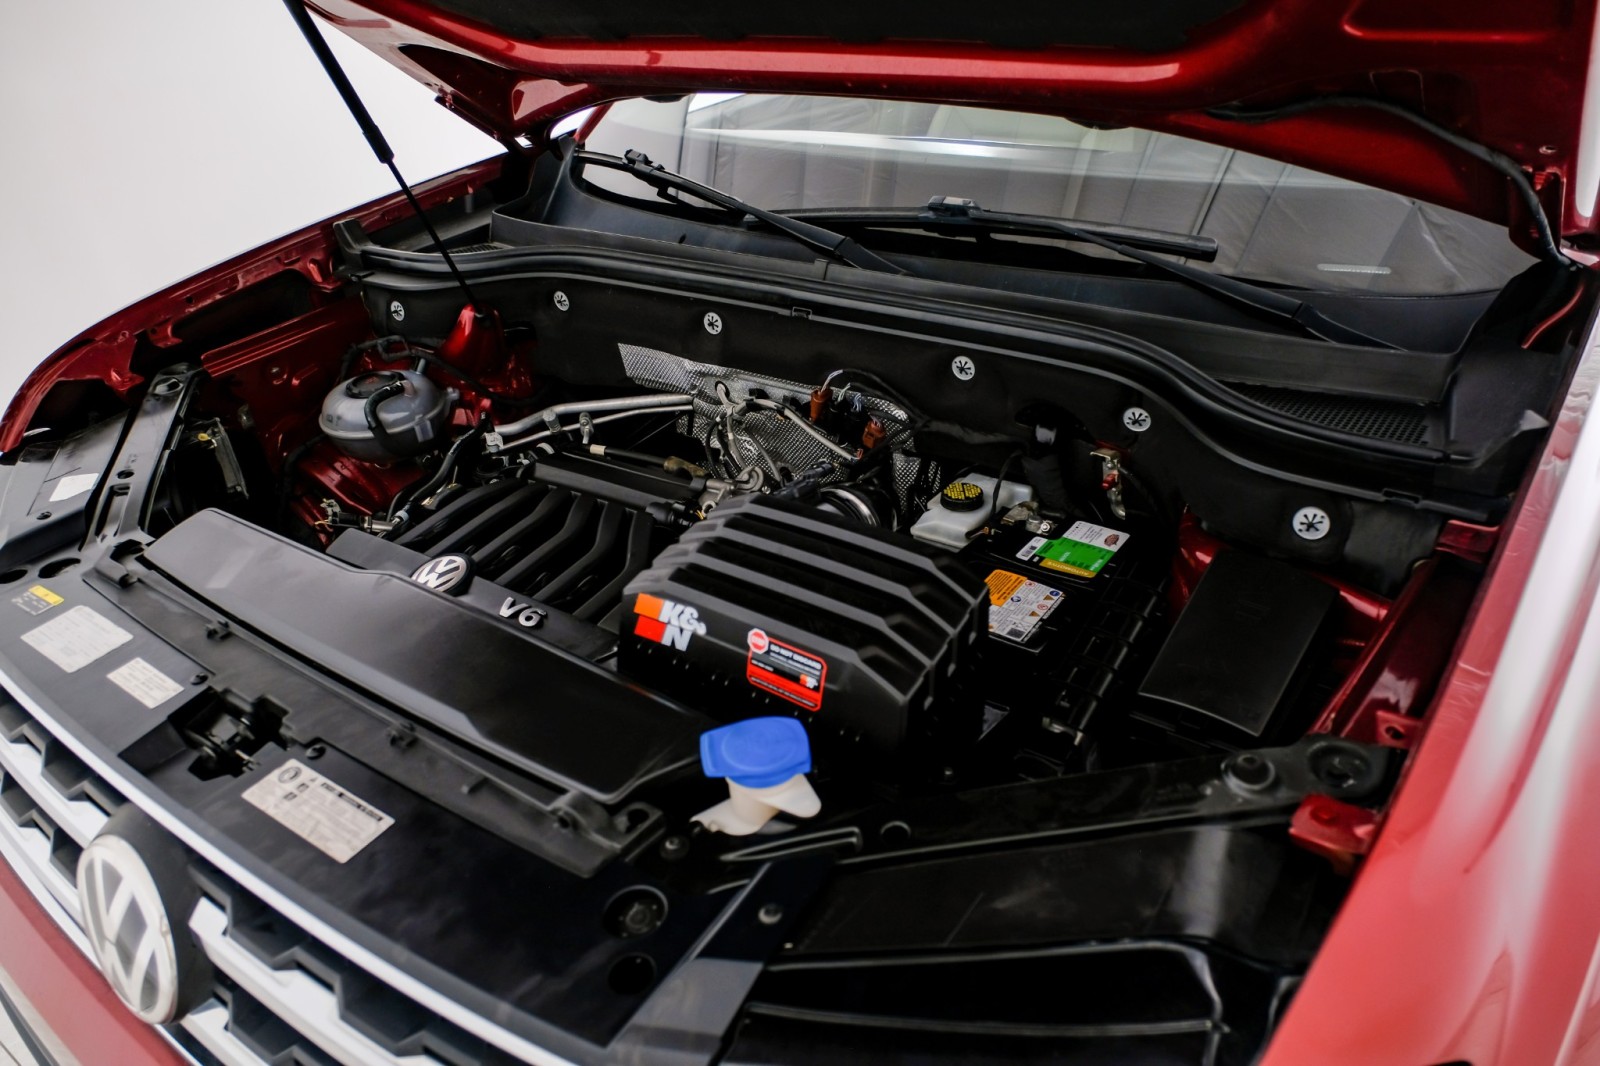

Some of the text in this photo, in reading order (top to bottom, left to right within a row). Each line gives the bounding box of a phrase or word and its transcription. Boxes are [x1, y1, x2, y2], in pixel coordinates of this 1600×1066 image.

[411, 555, 468, 592] VW
[499, 597, 547, 627] V6
[77, 835, 177, 1023] VW
